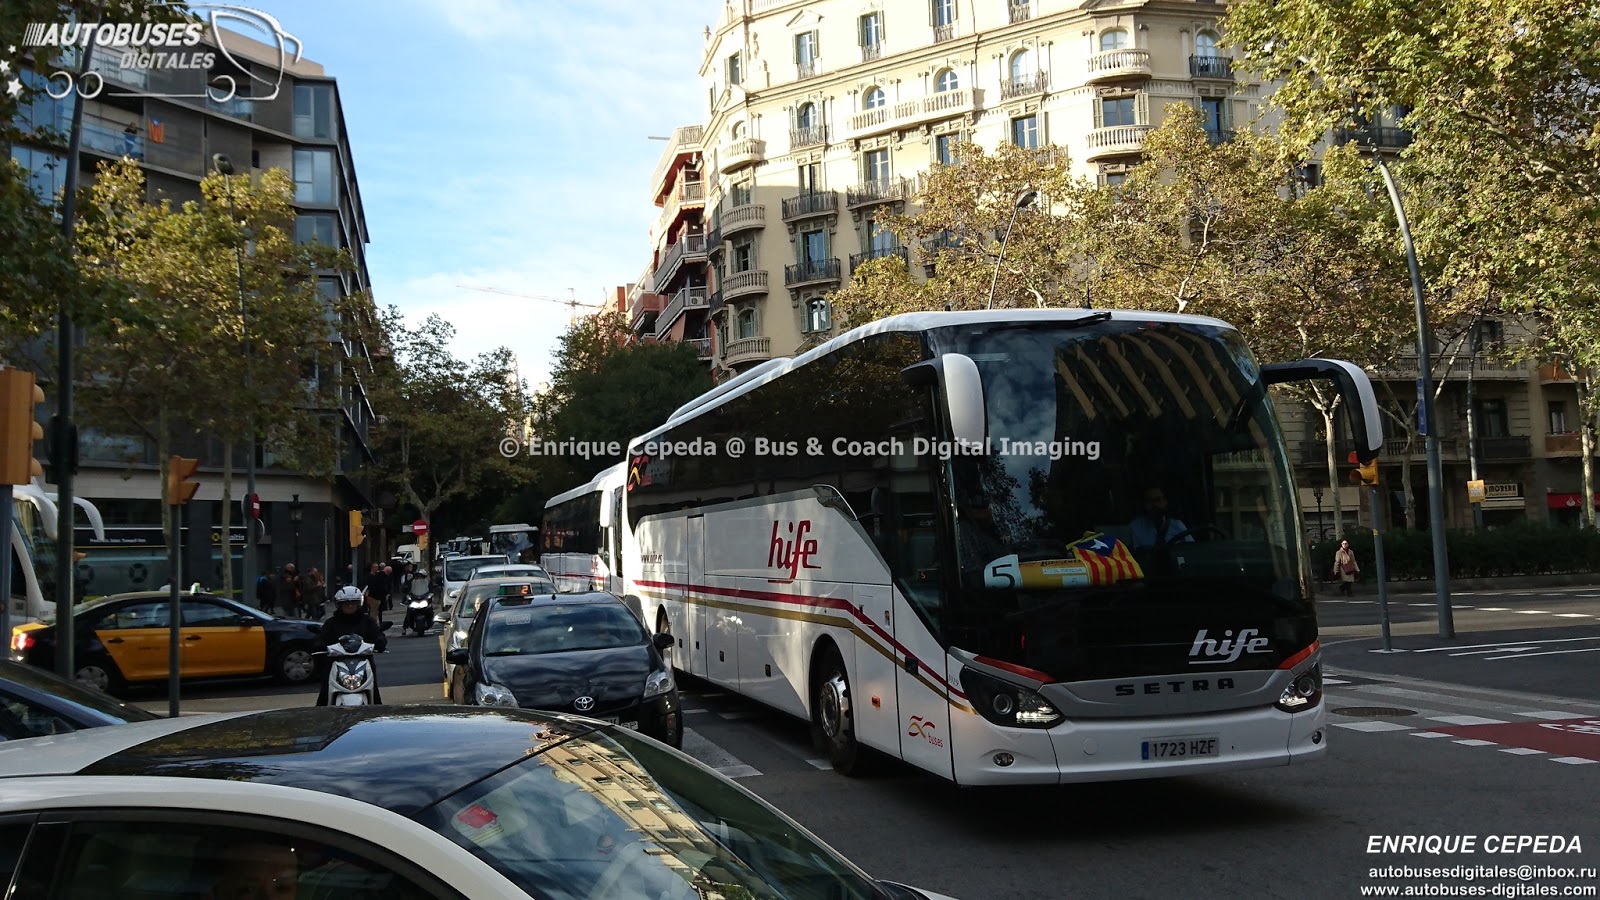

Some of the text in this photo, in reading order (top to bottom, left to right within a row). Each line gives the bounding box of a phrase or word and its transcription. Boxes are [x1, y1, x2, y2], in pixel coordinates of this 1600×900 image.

[1488, 485, 1517, 493] MORERA
[767, 520, 822, 584] hife
[992, 563, 1016, 590] 5
[1188, 628, 1274, 665] hife
[1115, 677, 1235, 697] SETRA
[928, 731, 944, 748] buses
[1153, 739, 1216, 757] 1723 HZF
